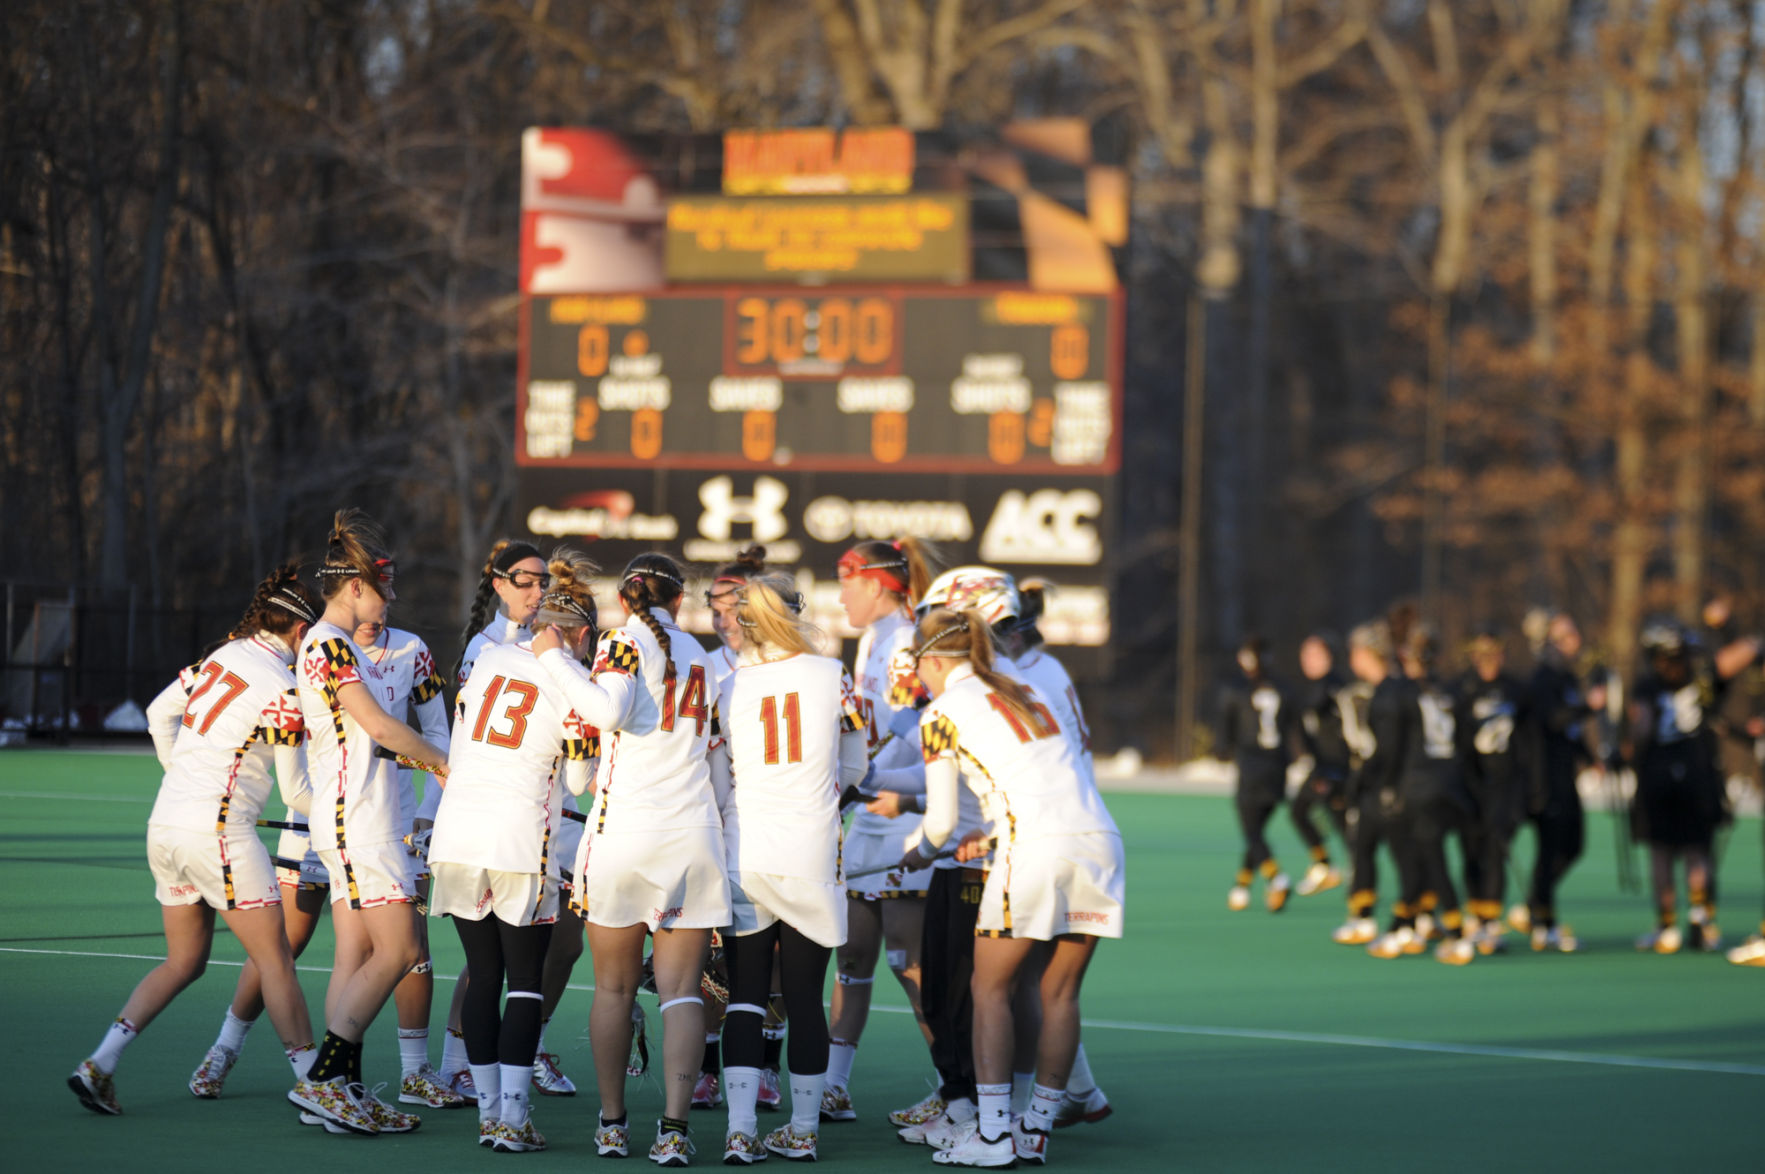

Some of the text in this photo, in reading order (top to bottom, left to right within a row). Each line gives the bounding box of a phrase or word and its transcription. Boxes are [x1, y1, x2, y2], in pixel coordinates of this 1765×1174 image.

[578, 325, 609, 377] 0
[738, 298, 893, 363] 30:00
[631, 408, 662, 459] 0
[742, 410, 775, 461] 0
[871, 411, 906, 463] 0
[988, 411, 1025, 464] 0
[979, 488, 1101, 565] ACC
[182, 661, 249, 736] 27
[472, 675, 539, 749] 13
[661, 665, 707, 737] 14
[760, 692, 802, 765] 11
[1064, 911, 1109, 926] TERRAPINS
